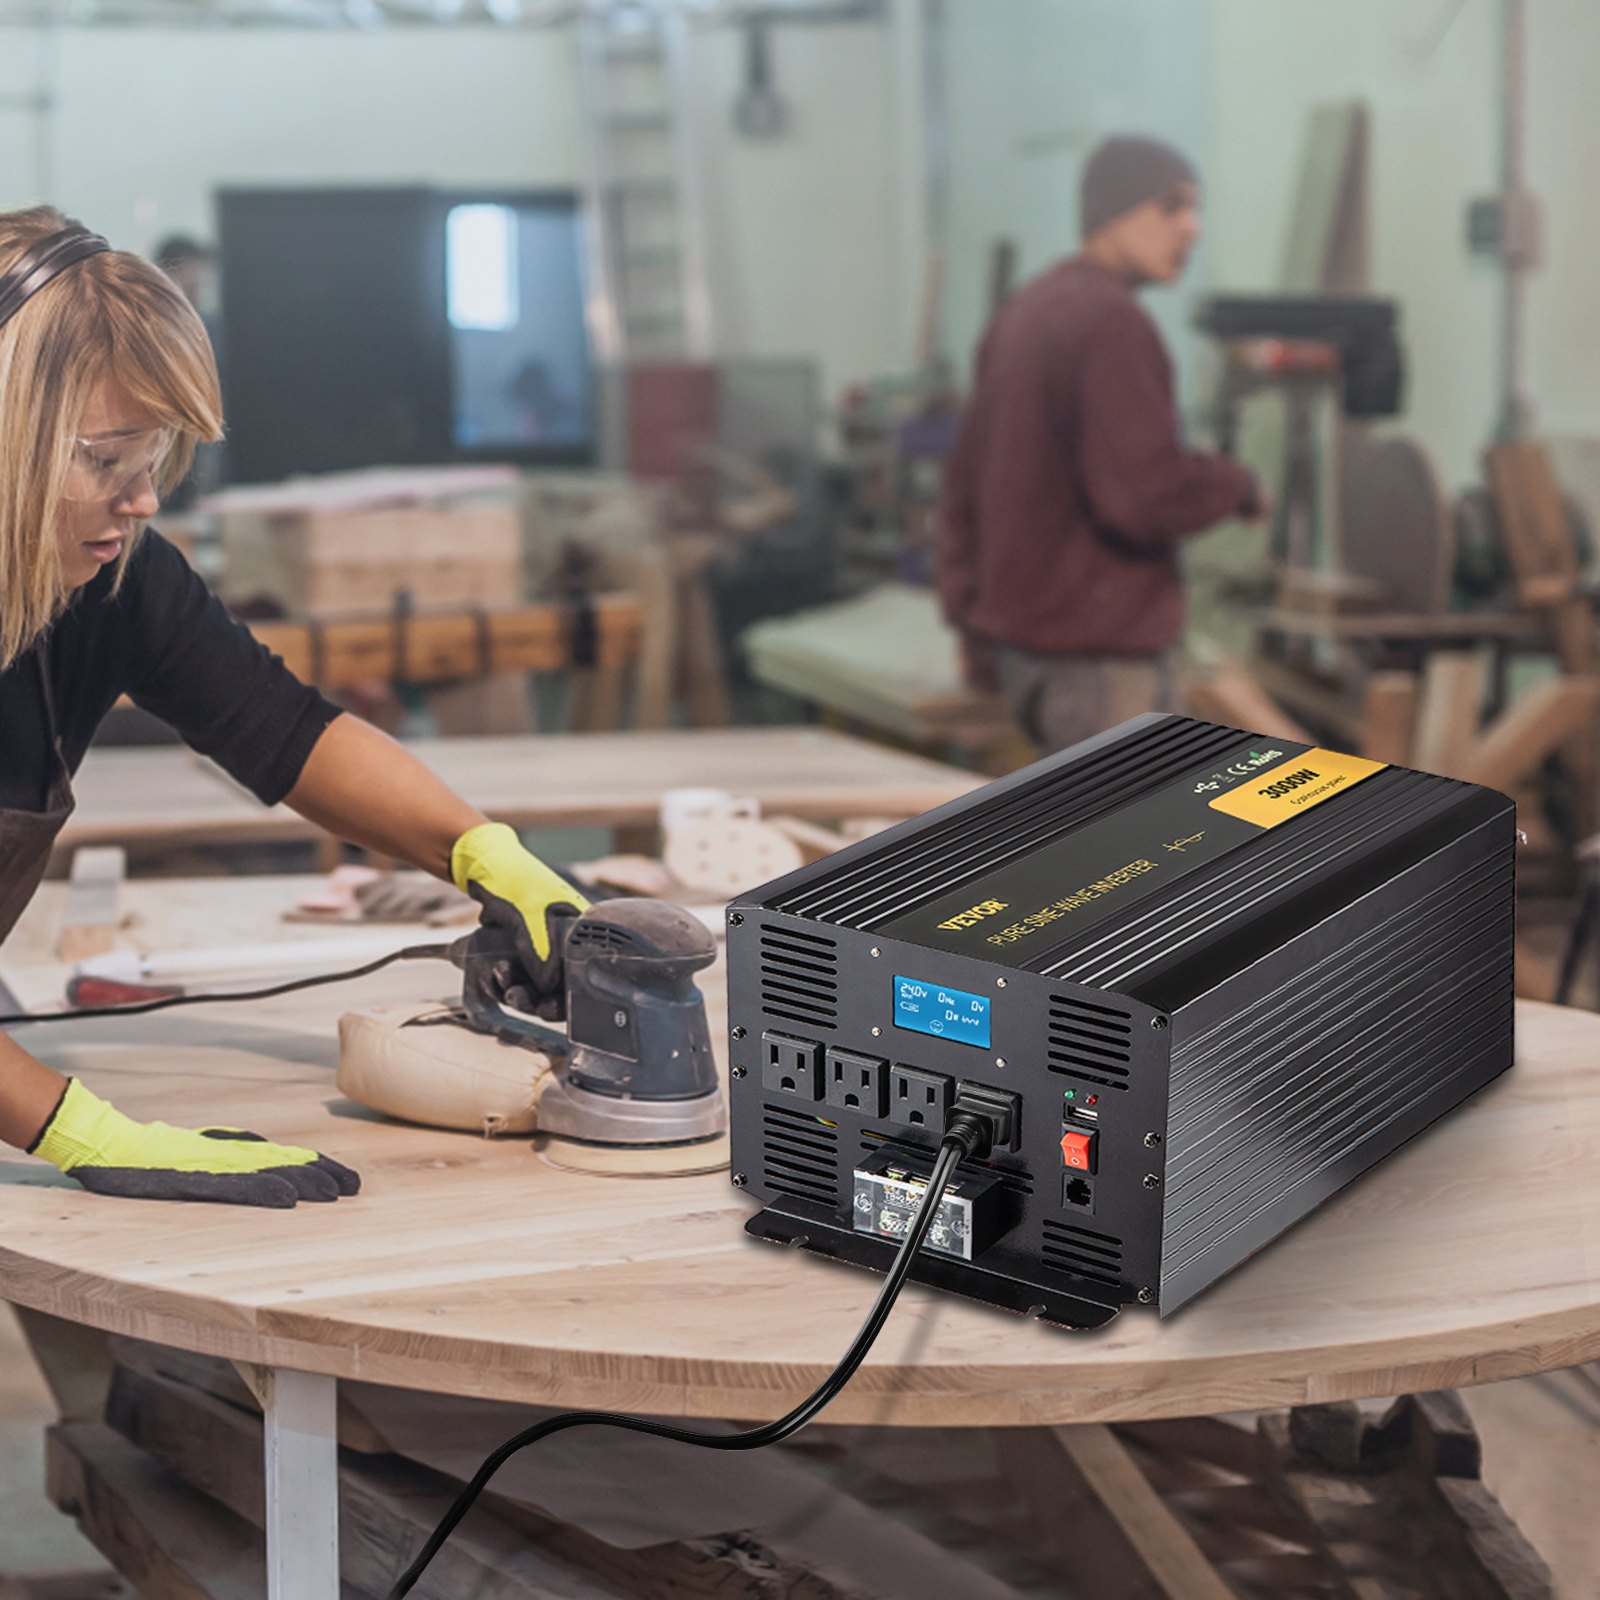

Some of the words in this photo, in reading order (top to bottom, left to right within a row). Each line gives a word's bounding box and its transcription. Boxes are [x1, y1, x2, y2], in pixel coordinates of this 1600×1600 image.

[1258, 768, 1320, 799] 3000W
[936, 898, 1009, 931] VEVOR
[986, 922, 1036, 947] PURE
[1023, 907, 1065, 927] SINE
[1051, 885, 1102, 912] WAVE
[1096, 859, 1159, 893] INVERTER
